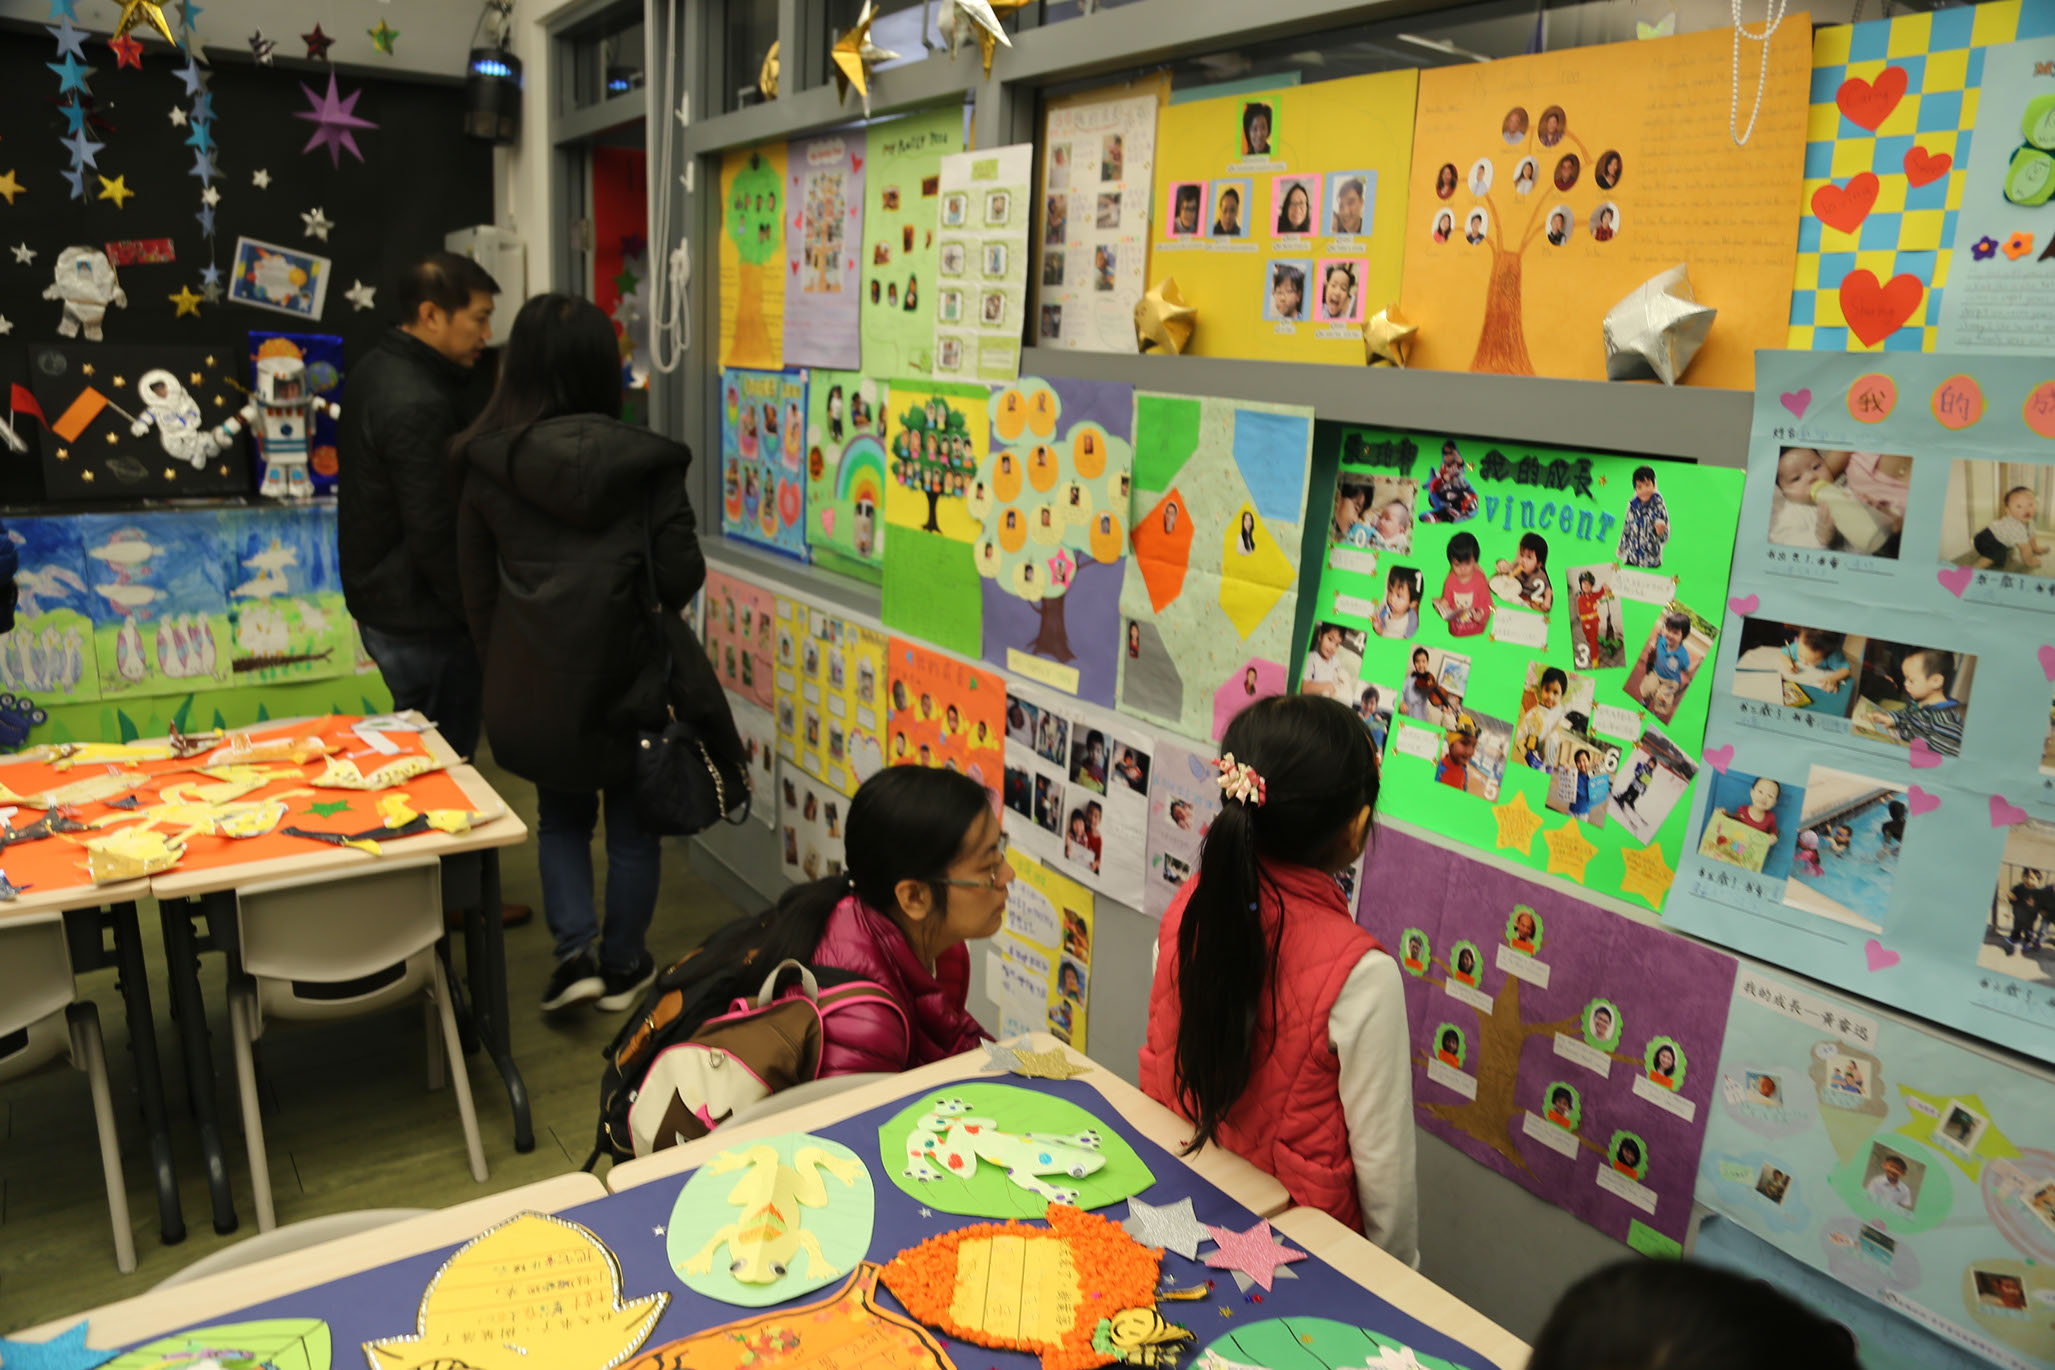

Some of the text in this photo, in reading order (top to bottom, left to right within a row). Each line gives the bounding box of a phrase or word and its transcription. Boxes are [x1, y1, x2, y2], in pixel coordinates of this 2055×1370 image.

[1531, 578, 1545, 603] 2
[1575, 643, 1590, 668] 3
[1605, 748, 1620, 773] 6
